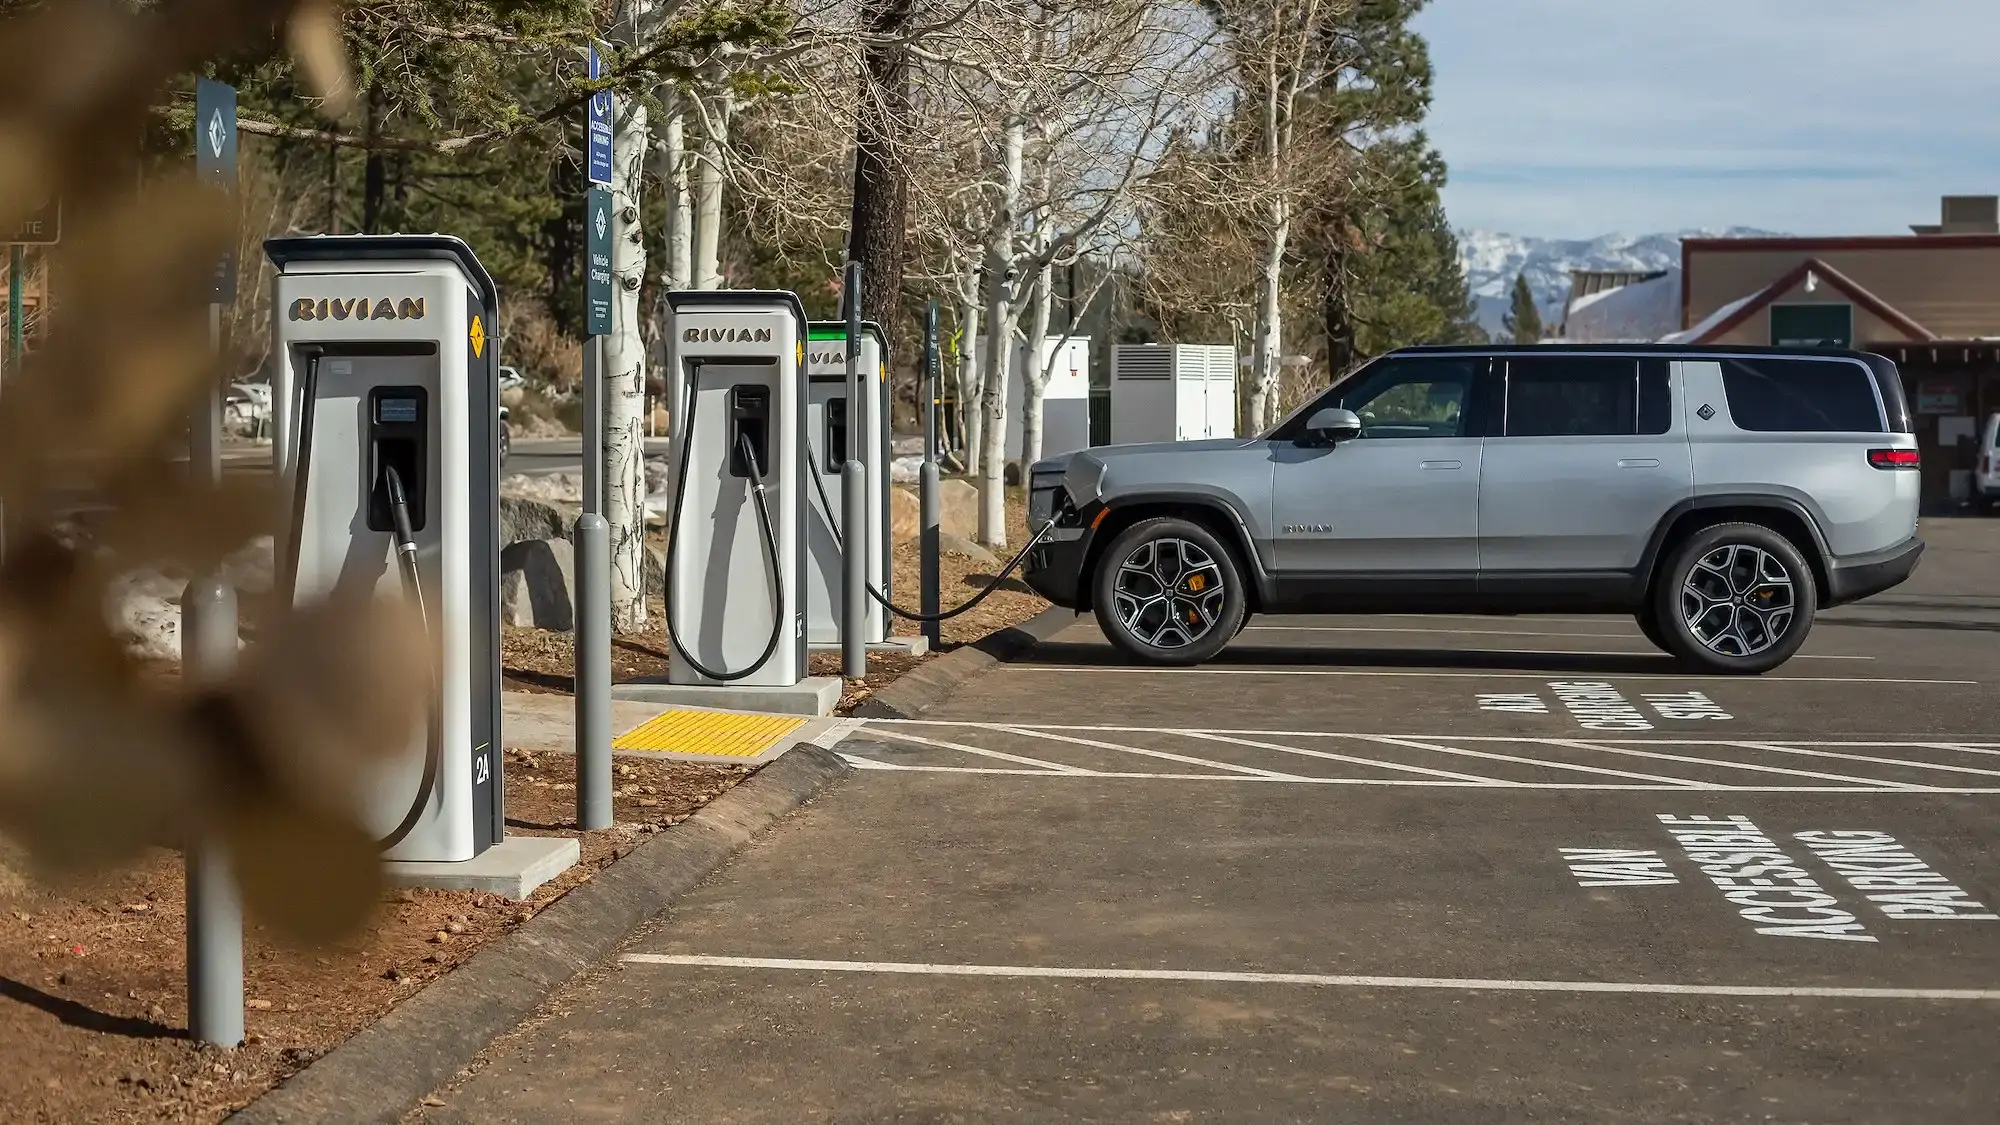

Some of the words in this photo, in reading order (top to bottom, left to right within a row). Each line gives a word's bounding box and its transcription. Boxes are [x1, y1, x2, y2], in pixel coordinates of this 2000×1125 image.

[592, 253, 609, 267] Vehicle
[591, 268, 610, 285] Charging
[288, 297, 426, 322] RIVIAN
[682, 328, 772, 343] RIVIAN
[809, 352, 845, 365] VIA
[1282, 524, 1334, 534] RIVIAN
[1546, 681, 1655, 731] CHARGING
[476, 753, 490, 785] 2A
[1558, 846, 1680, 888] VAN
[1655, 813, 1880, 943] ACCESSIBLE
[1792, 829, 2000, 921] PARKING
